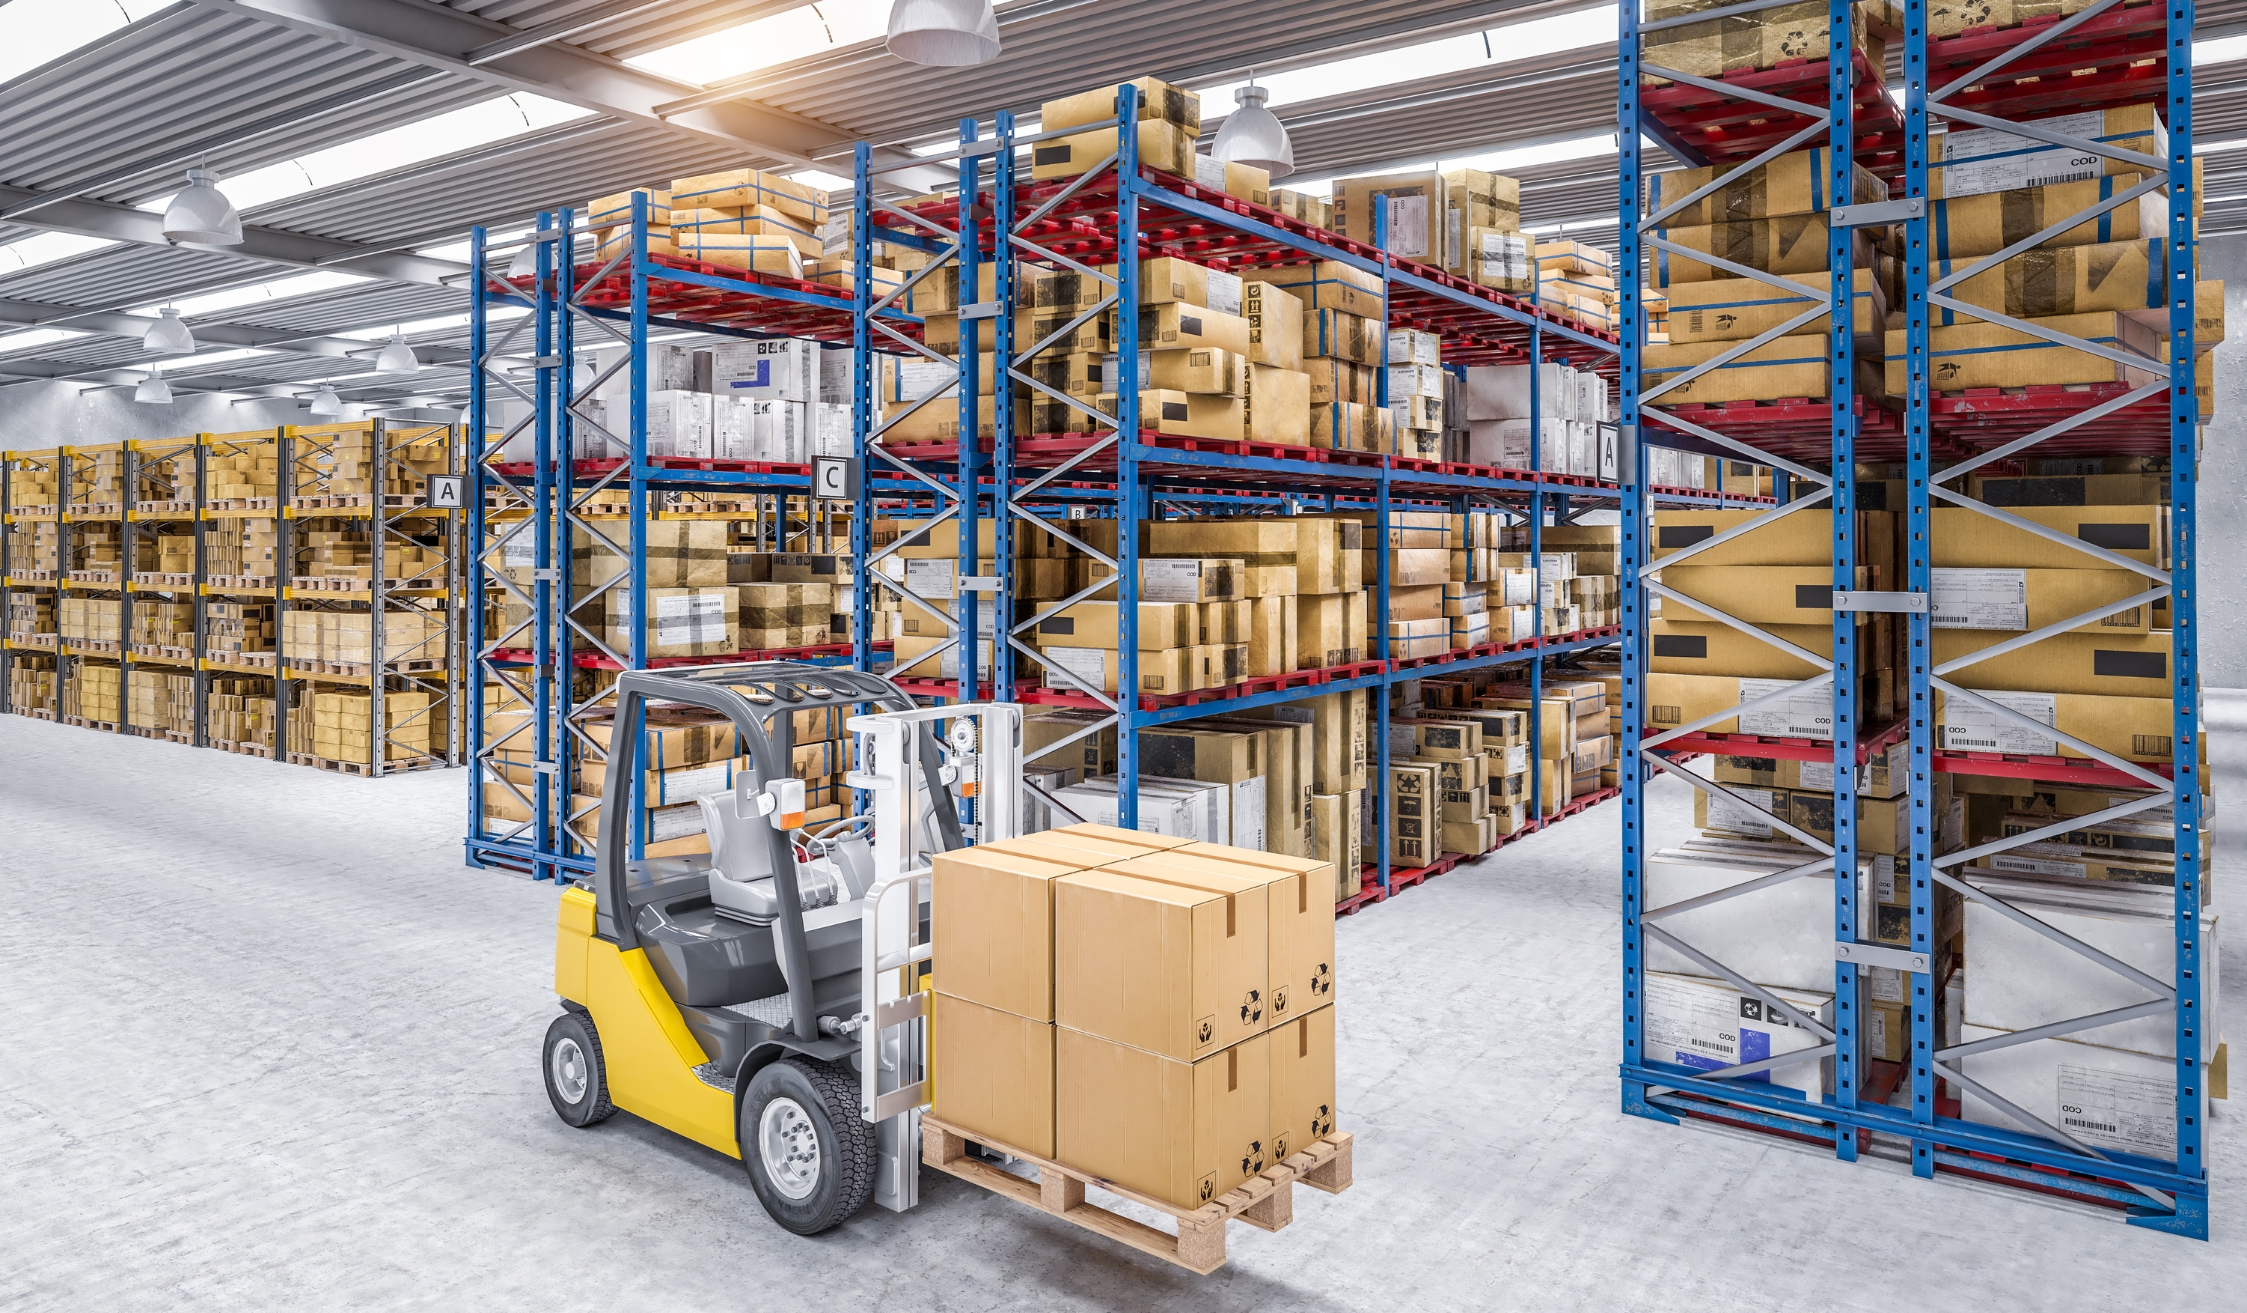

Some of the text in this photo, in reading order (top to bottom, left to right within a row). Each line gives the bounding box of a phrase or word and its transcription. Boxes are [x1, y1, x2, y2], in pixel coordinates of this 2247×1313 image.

[2070, 156, 2098, 167] COD
[1605, 436, 1614, 468] A
[825, 466, 839, 489] C
[440, 482, 455, 500] A
[1075, 509, 1082, 519] B
[1814, 717, 1832, 725] COD
[1718, 1032, 1737, 1042] COD
